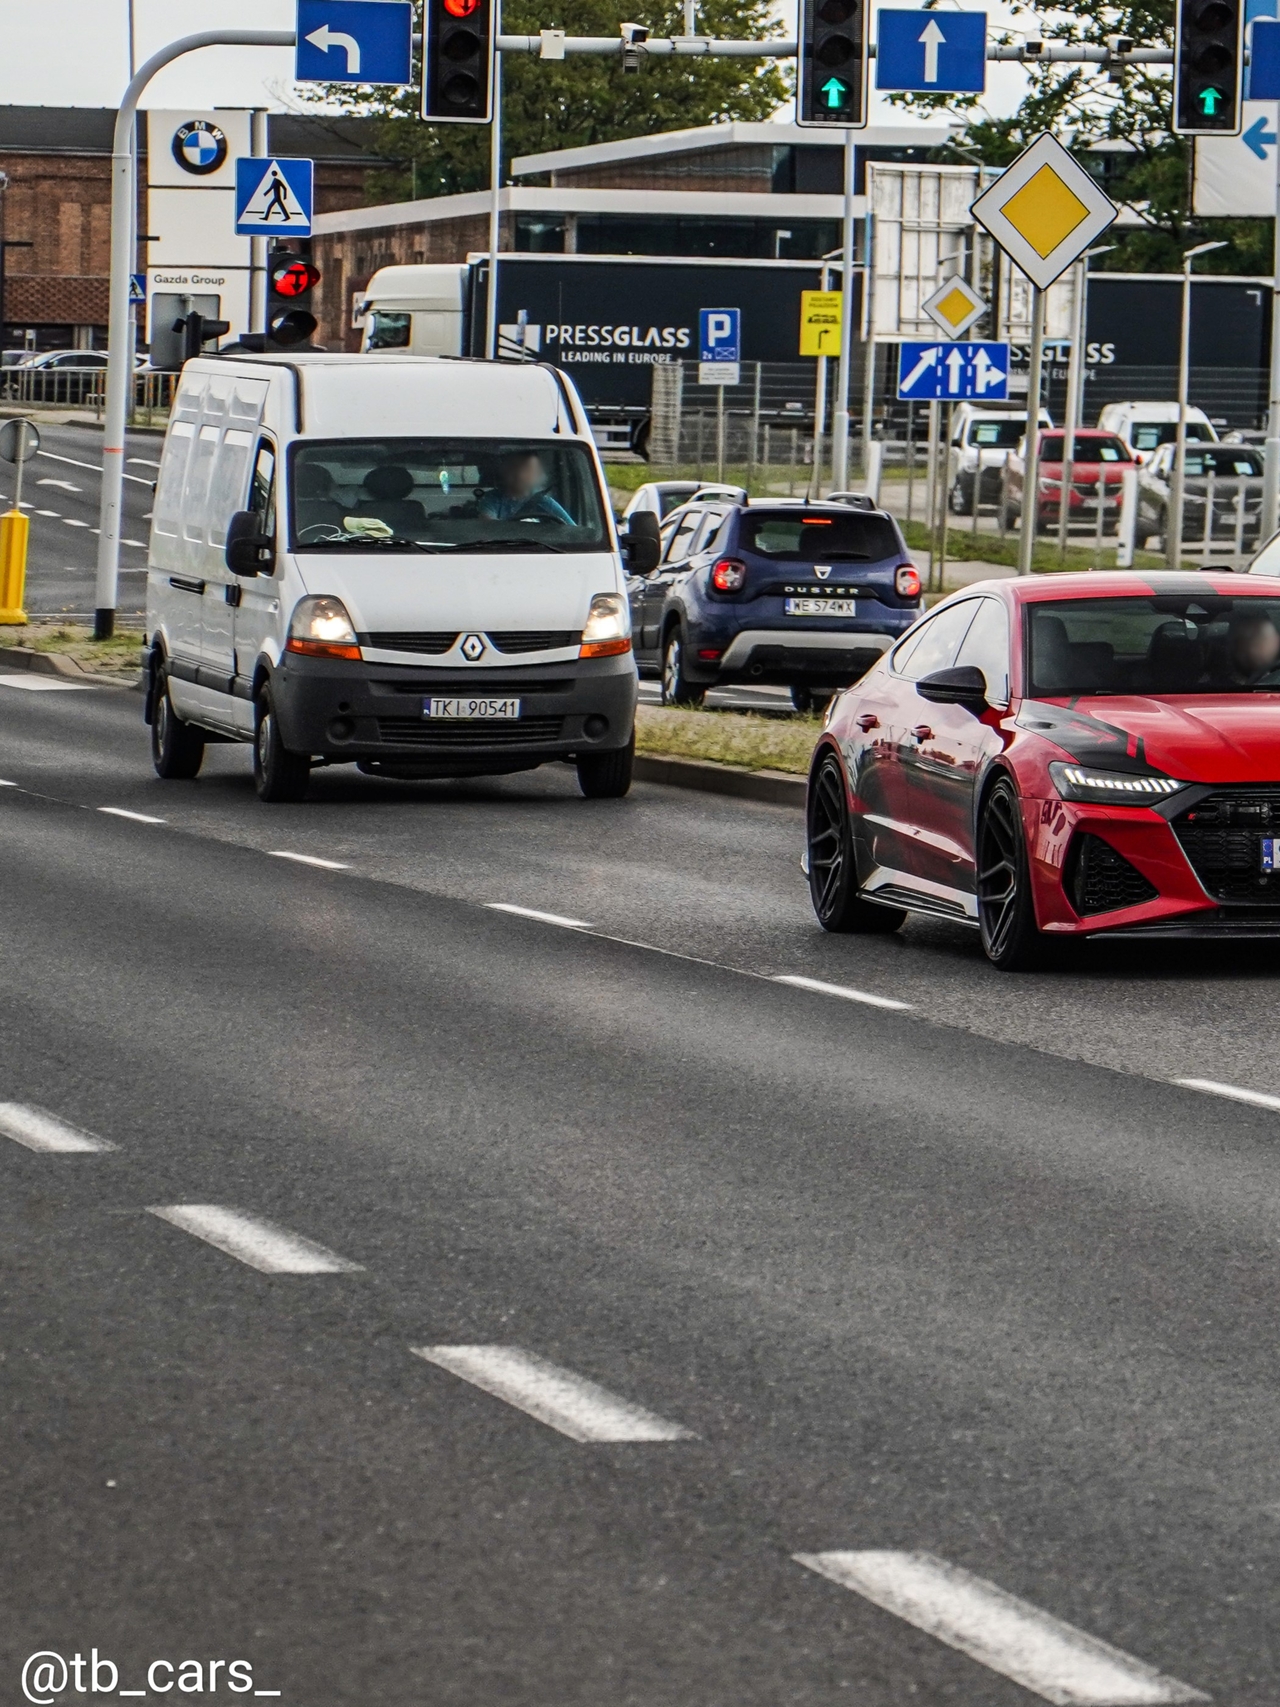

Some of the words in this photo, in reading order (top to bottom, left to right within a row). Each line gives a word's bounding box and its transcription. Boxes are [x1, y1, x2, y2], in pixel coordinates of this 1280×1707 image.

[177, 121, 224, 140] BMW
[154, 274, 188, 284] Gazda
[191, 274, 225, 286] Group
[545, 324, 690, 348] PRESSGLASS
[708, 313, 731, 347] P
[561, 351, 610, 363] LEADING
[613, 352, 625, 364] IN
[629, 352, 673, 364] EUROPE
[784, 586, 859, 595] DUSTER
[432, 700, 460, 716] TKI
[468, 700, 516, 716] 90541
